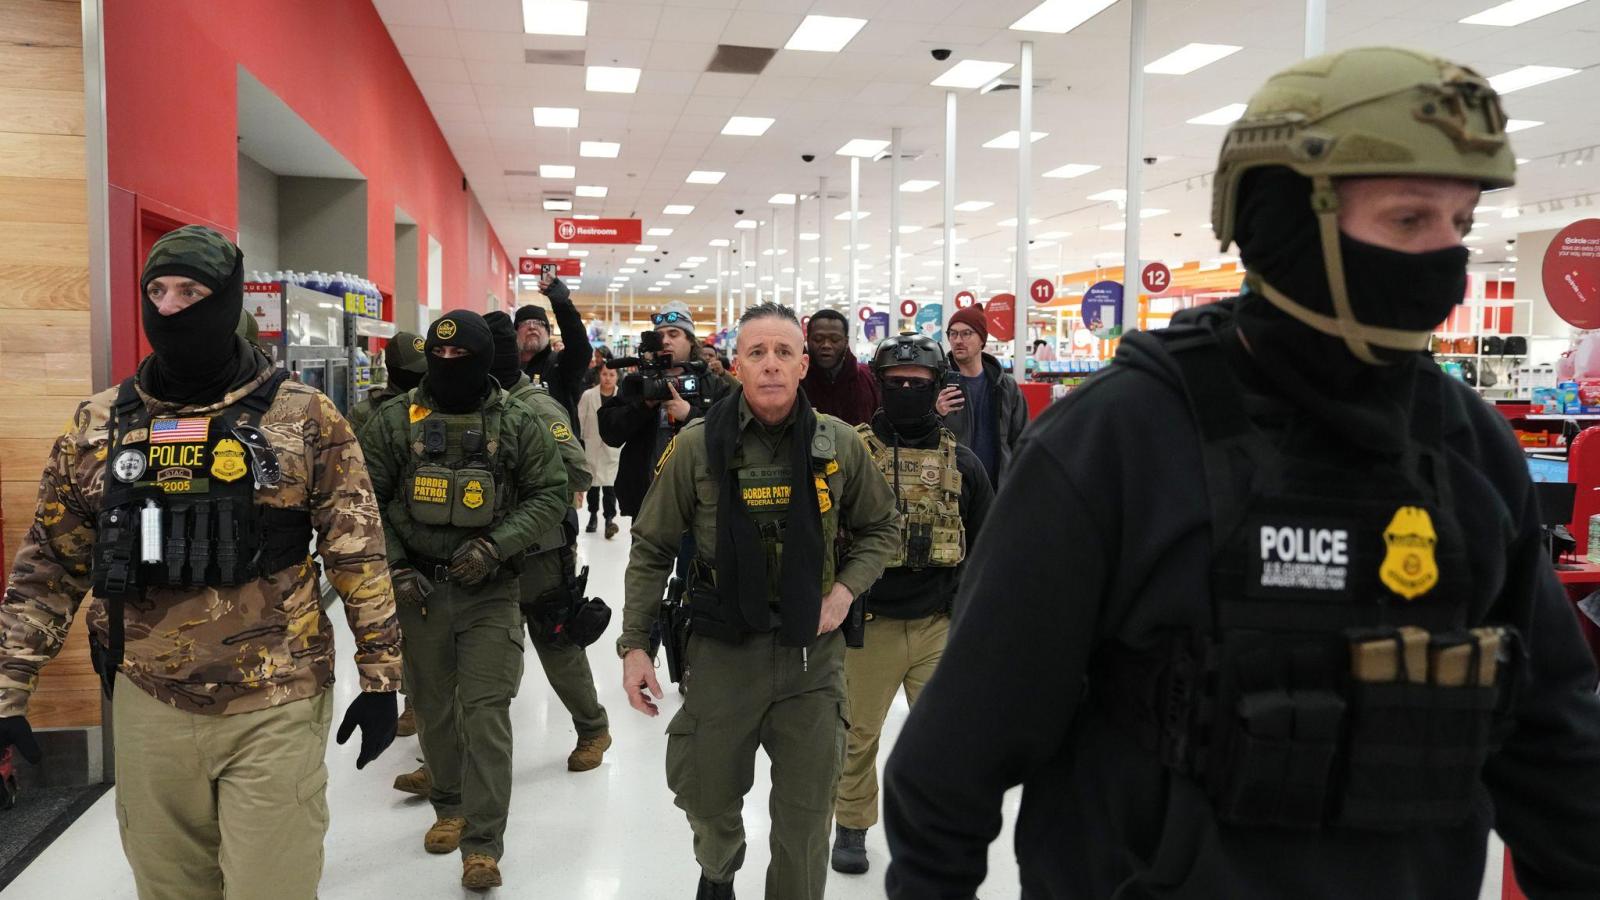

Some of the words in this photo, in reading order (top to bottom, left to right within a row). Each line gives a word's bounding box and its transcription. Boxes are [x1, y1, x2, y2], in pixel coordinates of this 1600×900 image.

[577, 226, 617, 235] Restrooms
[1147, 271, 1165, 285] 12
[1036, 286, 1049, 297] 11
[149, 445, 204, 467] POLICE
[888, 460, 919, 472] PLICE
[415, 476, 448, 488] BORDER
[414, 486, 447, 497] PATROL
[743, 487, 772, 500] BORDER
[772, 486, 792, 498] PATR
[1260, 526, 1348, 564] POLICE
[1282, 562, 1326, 576] CUSTOMS
